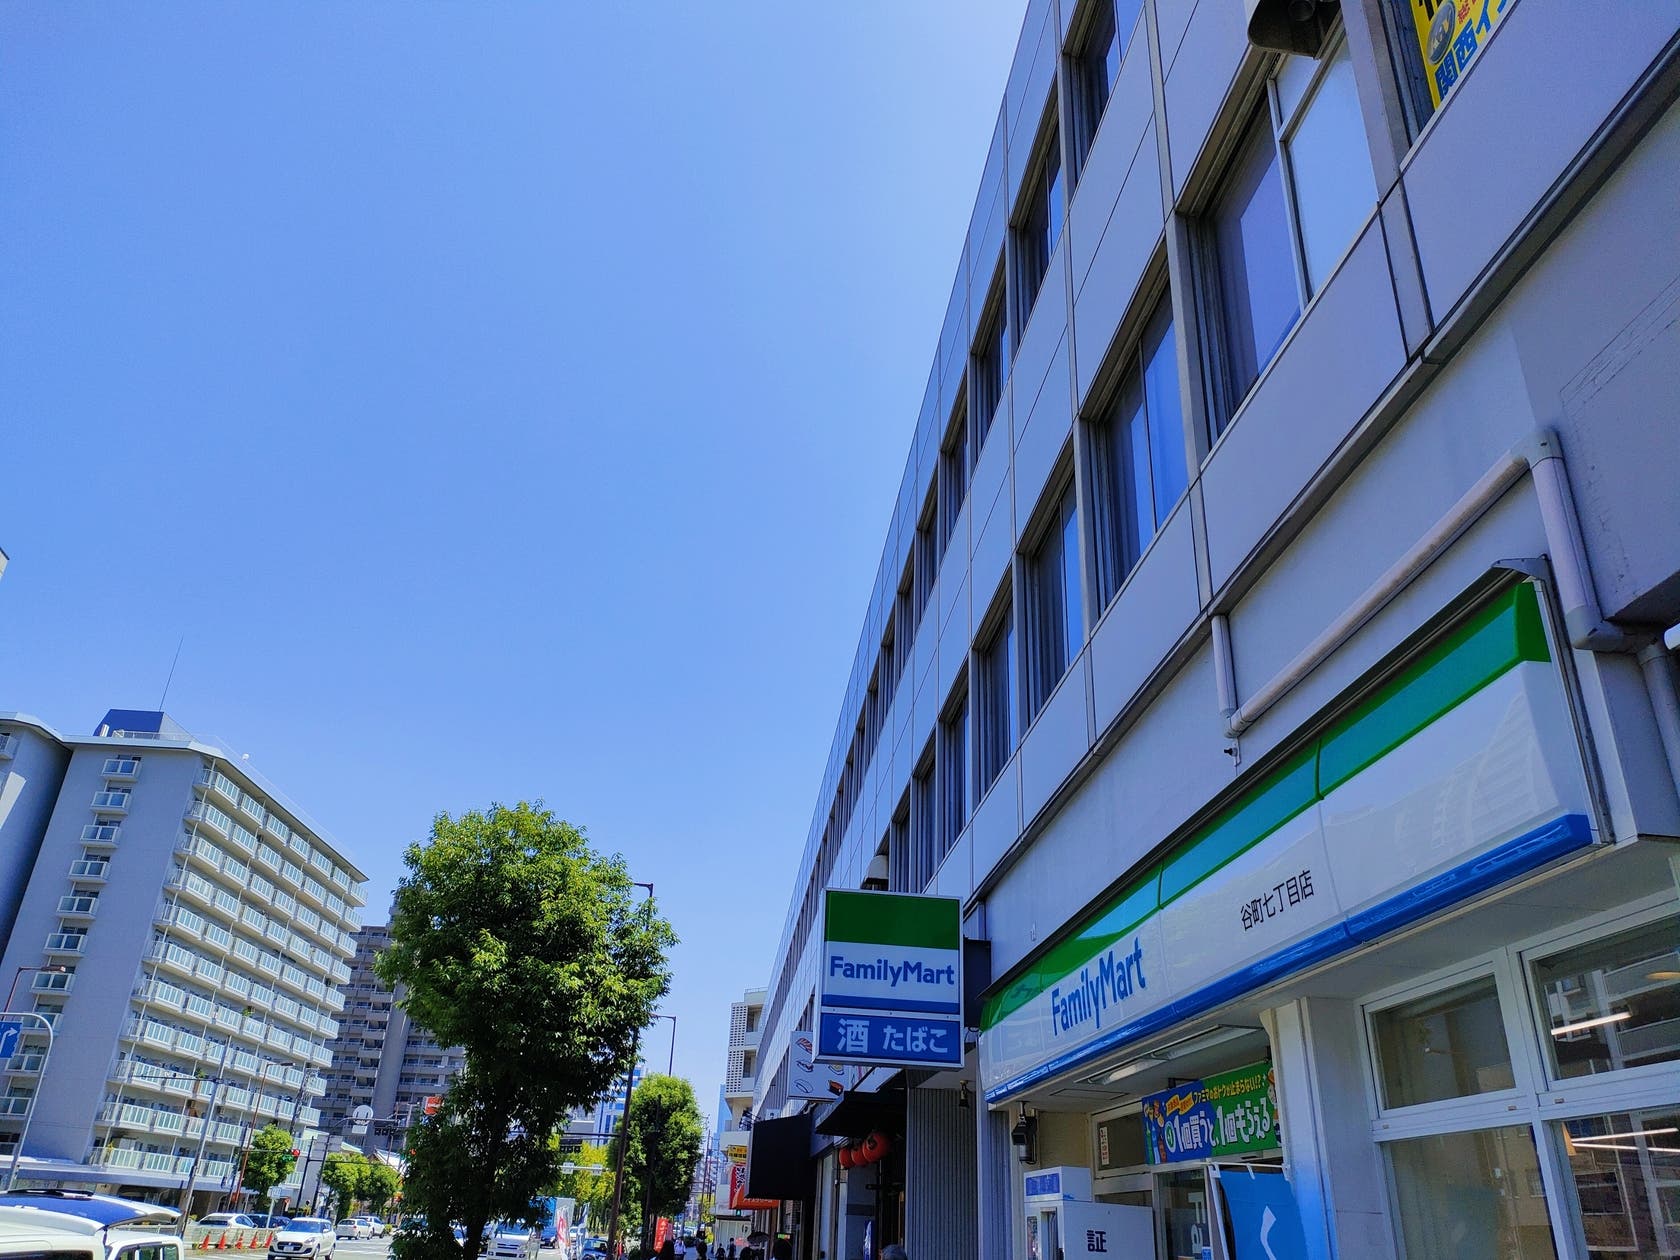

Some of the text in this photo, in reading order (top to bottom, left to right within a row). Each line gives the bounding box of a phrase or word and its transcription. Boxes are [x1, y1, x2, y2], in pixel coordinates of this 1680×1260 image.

[1240, 869, 1315, 931] 谷町七丁目店
[830, 955, 955, 988] FamilyMart
[1050, 936, 1147, 1036] FamilyMart
[836, 1017, 949, 1054] 酒 たばこ
[1086, 1229, 1108, 1253] 証
